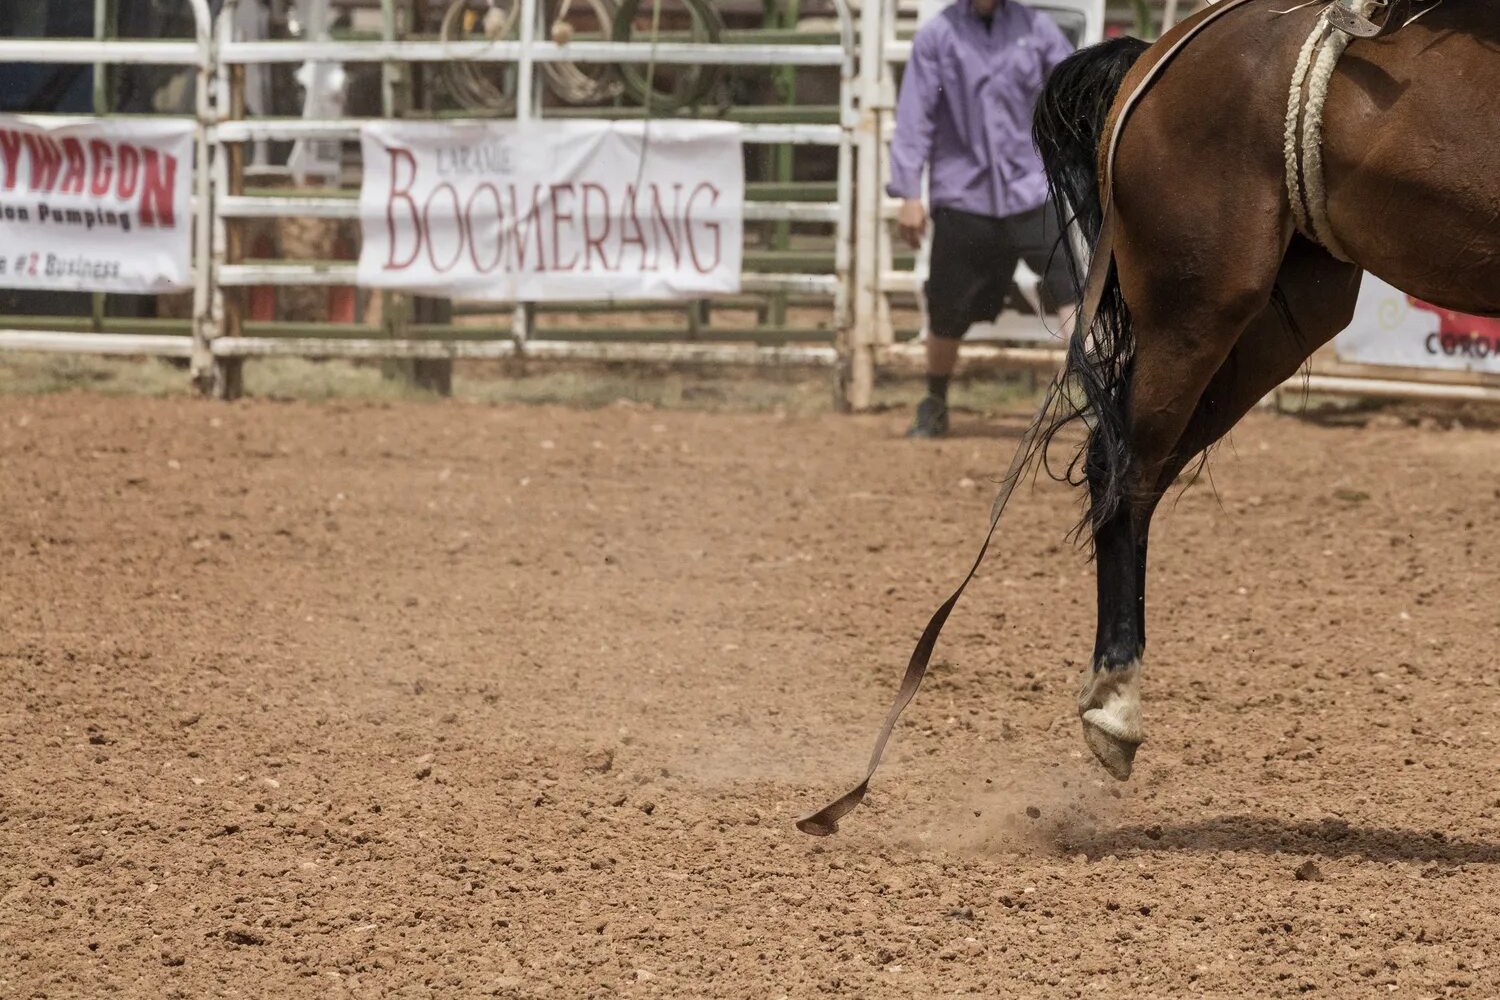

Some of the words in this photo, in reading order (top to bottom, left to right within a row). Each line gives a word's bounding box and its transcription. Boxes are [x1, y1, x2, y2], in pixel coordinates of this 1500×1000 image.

[38, 202, 131, 232] Pumping
[382, 147, 722, 274] BOOMERANG
[45, 253, 119, 279] Business
